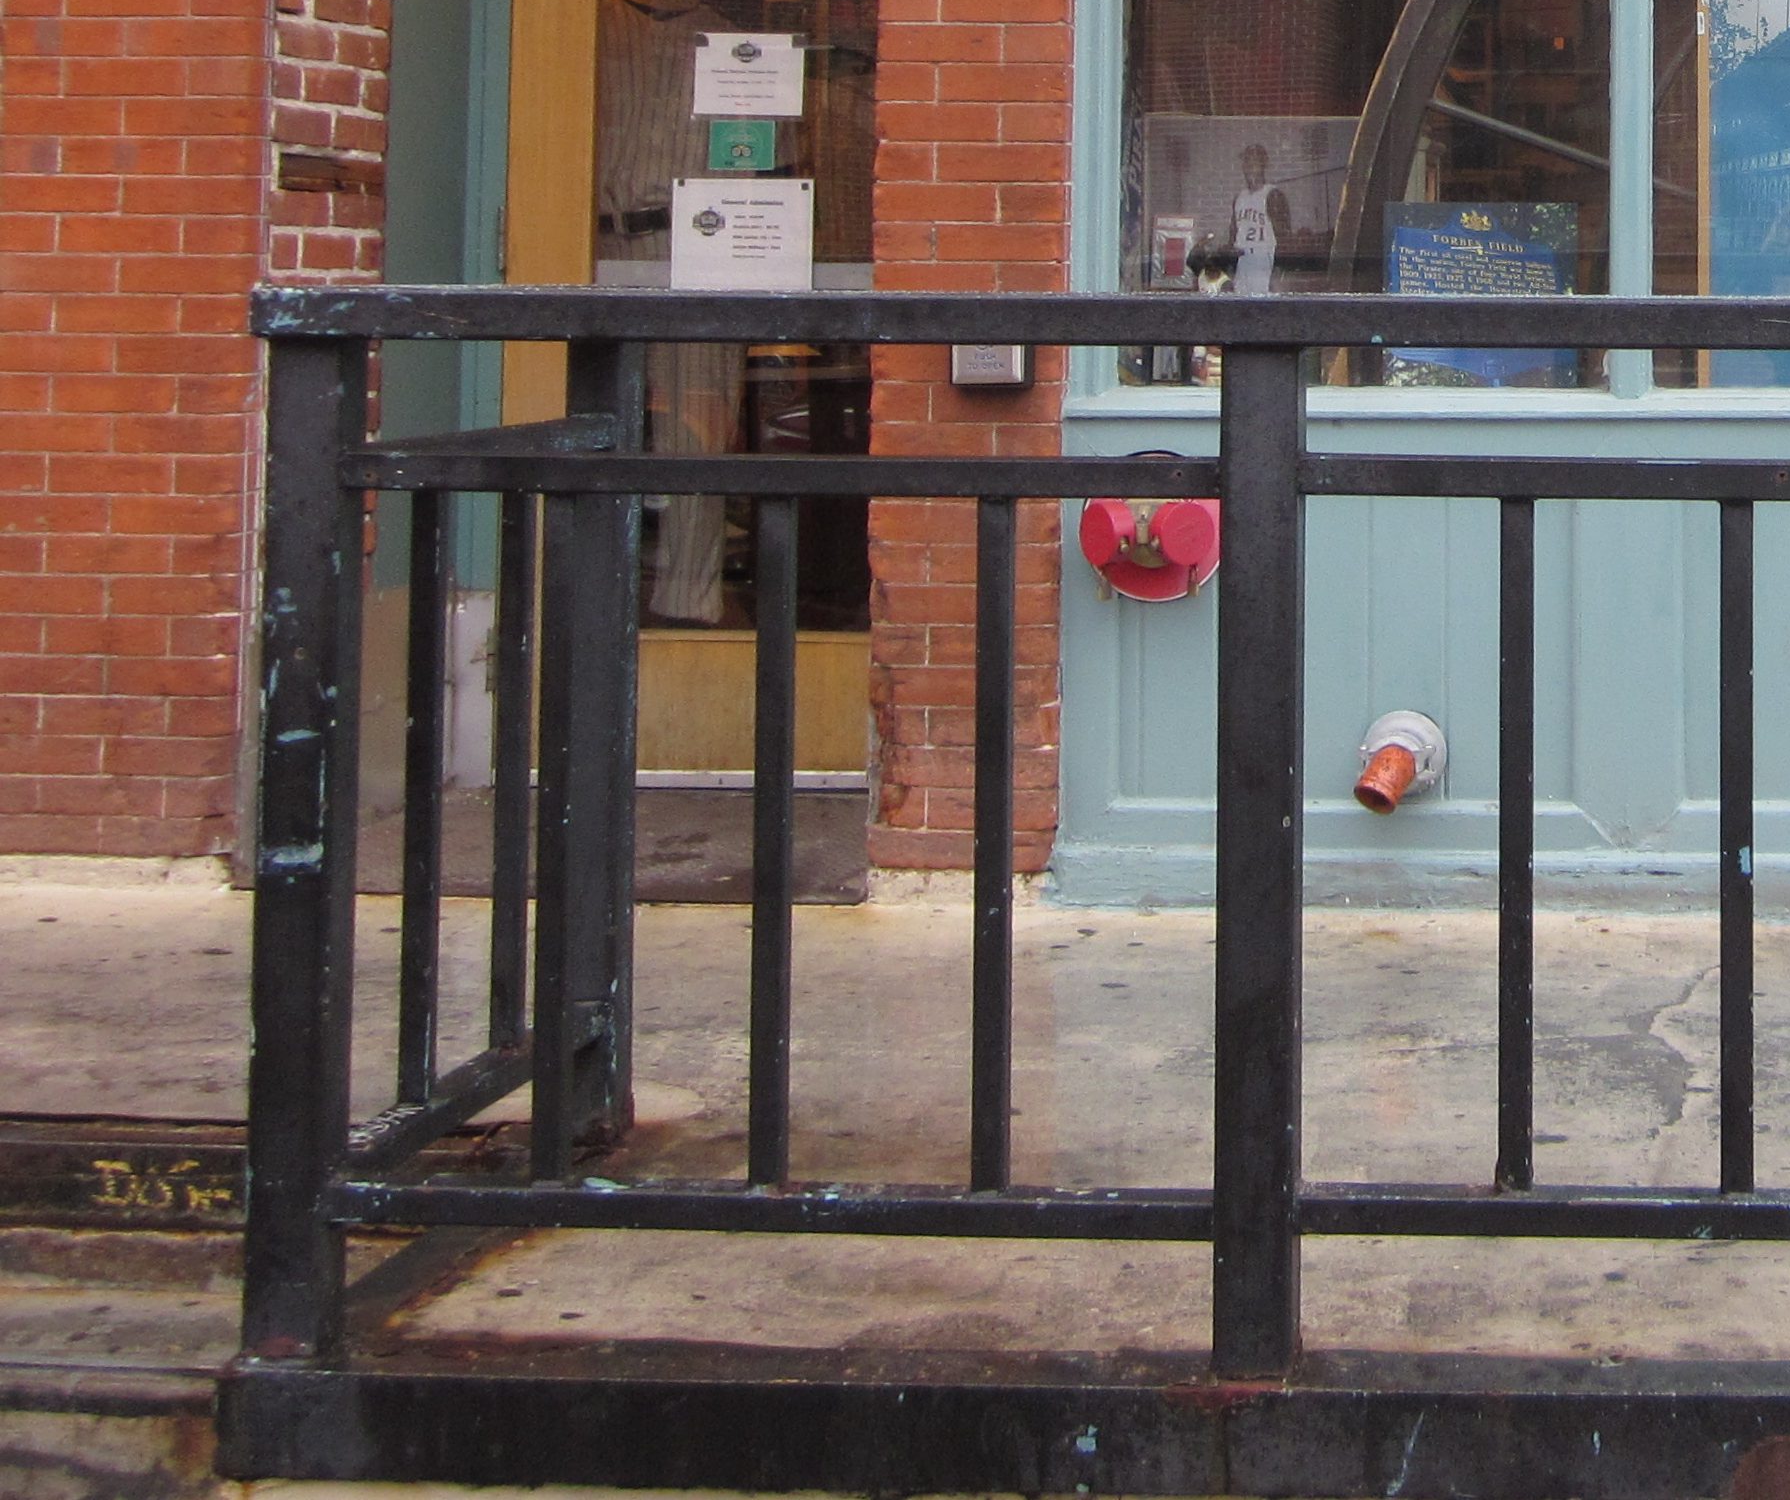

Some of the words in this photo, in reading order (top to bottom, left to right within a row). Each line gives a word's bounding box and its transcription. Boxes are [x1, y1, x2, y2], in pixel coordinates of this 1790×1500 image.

[1246, 227, 1265, 241] 21
[1432, 234, 1482, 247] FORBES
[1489, 241, 1525, 253] FIELD
